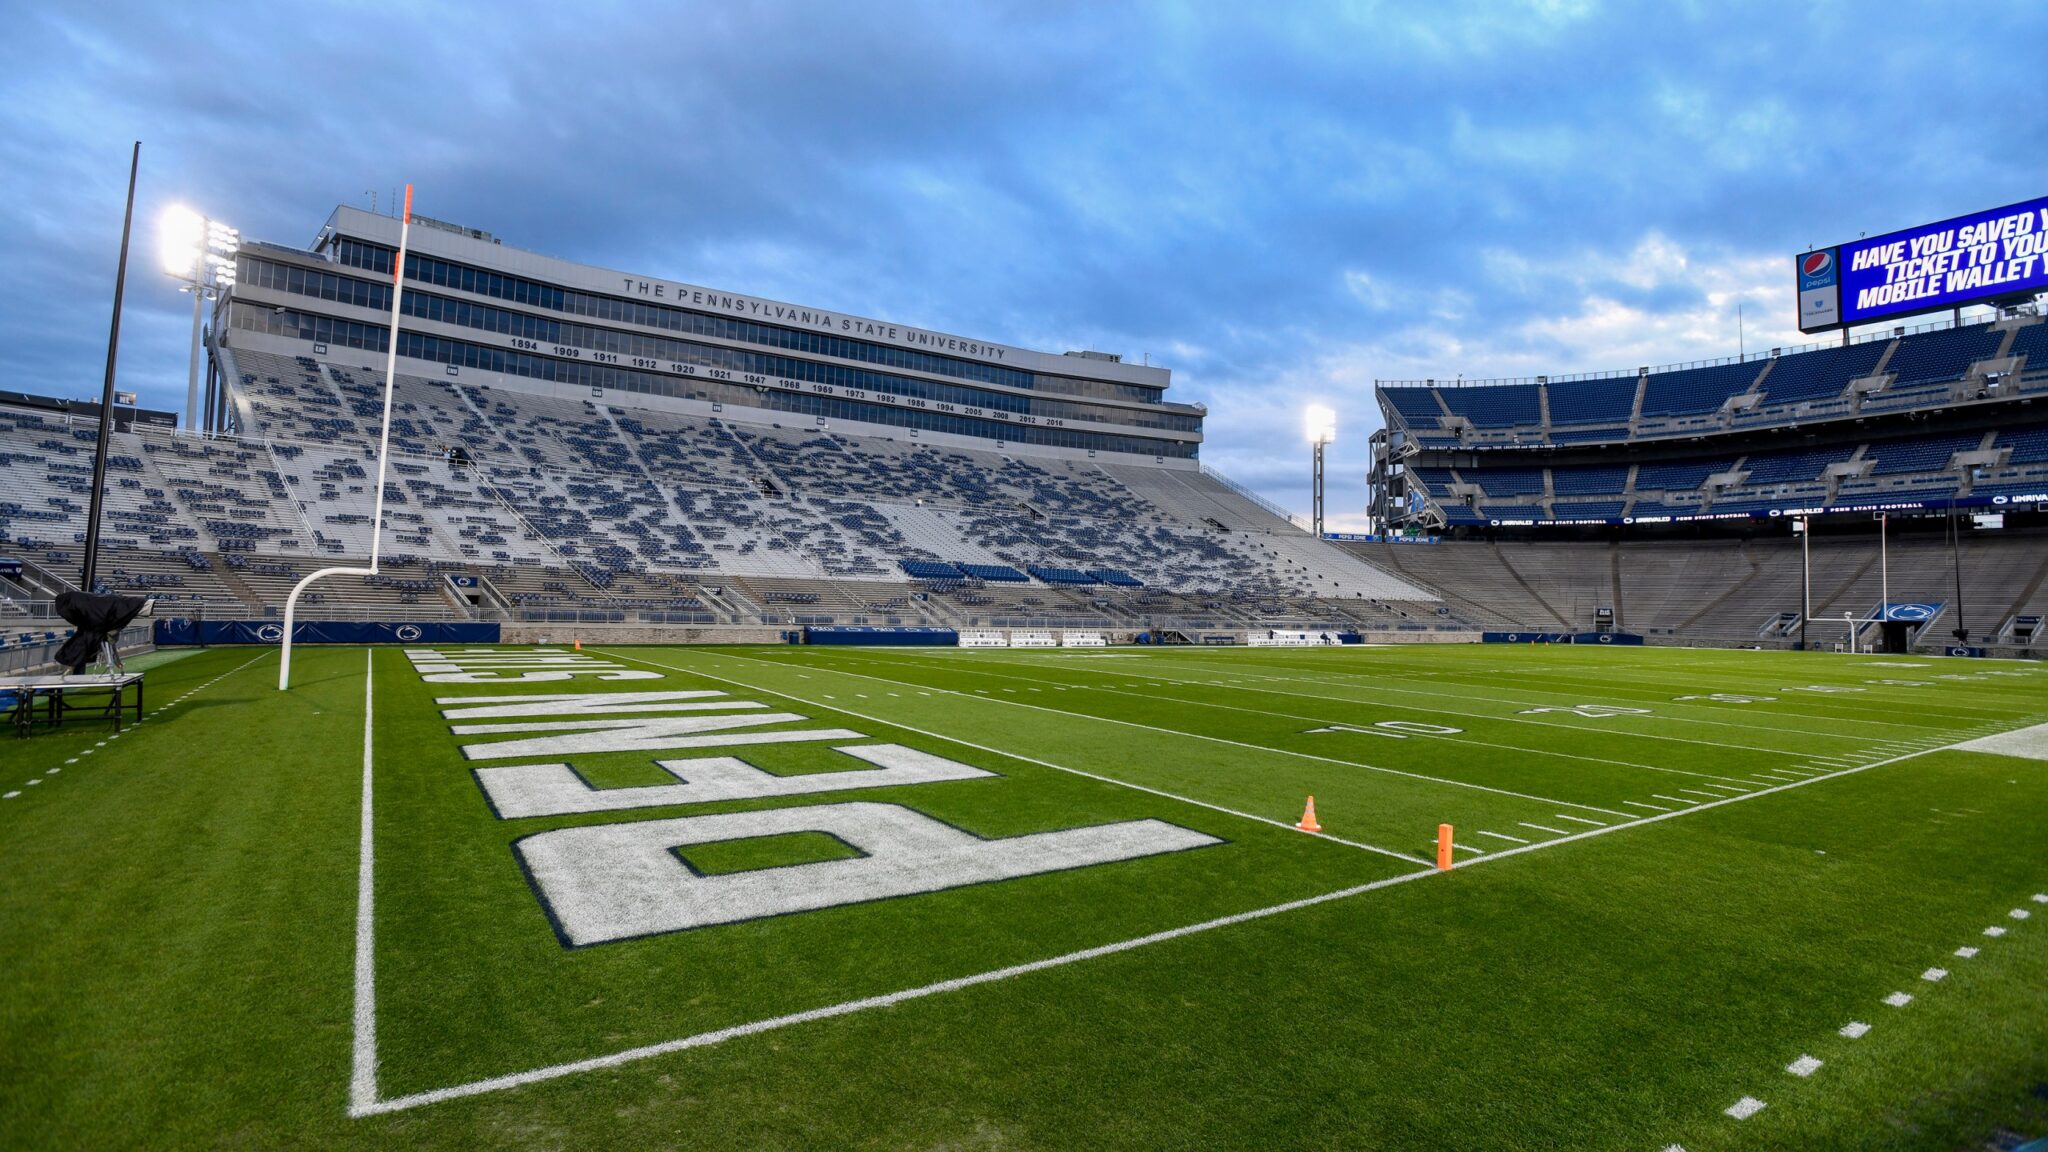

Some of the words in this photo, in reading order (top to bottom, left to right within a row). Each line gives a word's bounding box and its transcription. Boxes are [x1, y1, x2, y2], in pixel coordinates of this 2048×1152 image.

[1851, 240, 1906, 272] HAVE
[1910, 229, 1955, 256] YOU
[1957, 211, 2035, 247] SAVED
[1885, 248, 1965, 284] TICKET
[1967, 241, 1998, 268] TO
[1806, 276, 1831, 289] pepsi
[1856, 275, 1943, 310] MOBILE
[1946, 254, 2039, 294] WALLET
[624, 278, 665, 297] THE
[677, 288, 832, 327] PENNSYLVANIA
[841, 319, 897, 339] STATE
[906, 331, 1006, 360] UNIVERSITY
[511, 338, 538, 351] 1894
[553, 346, 579, 358] 1909
[593, 352, 618, 363] 1911
[632, 358, 657, 369] 1912
[671, 363, 695, 374] 1920
[708, 369, 731, 380] 1921
[744, 374, 766, 384] 1947
[779, 379, 801, 390] 1968
[812, 384, 833, 394] 1969
[845, 389, 865, 399] 1973
[876, 394, 896, 404] 1982
[907, 398, 926, 408] 1986
[936, 402, 955, 412] 1994
[964, 407, 983, 416] 2005
[1019, 415, 1036, 424] 2012
[1046, 418, 1064, 427] 2016
[1783, 508, 1824, 516] UNRIVALED
[1326, 721, 1465, 739] 10
[433, 689, 1229, 947] PENN
